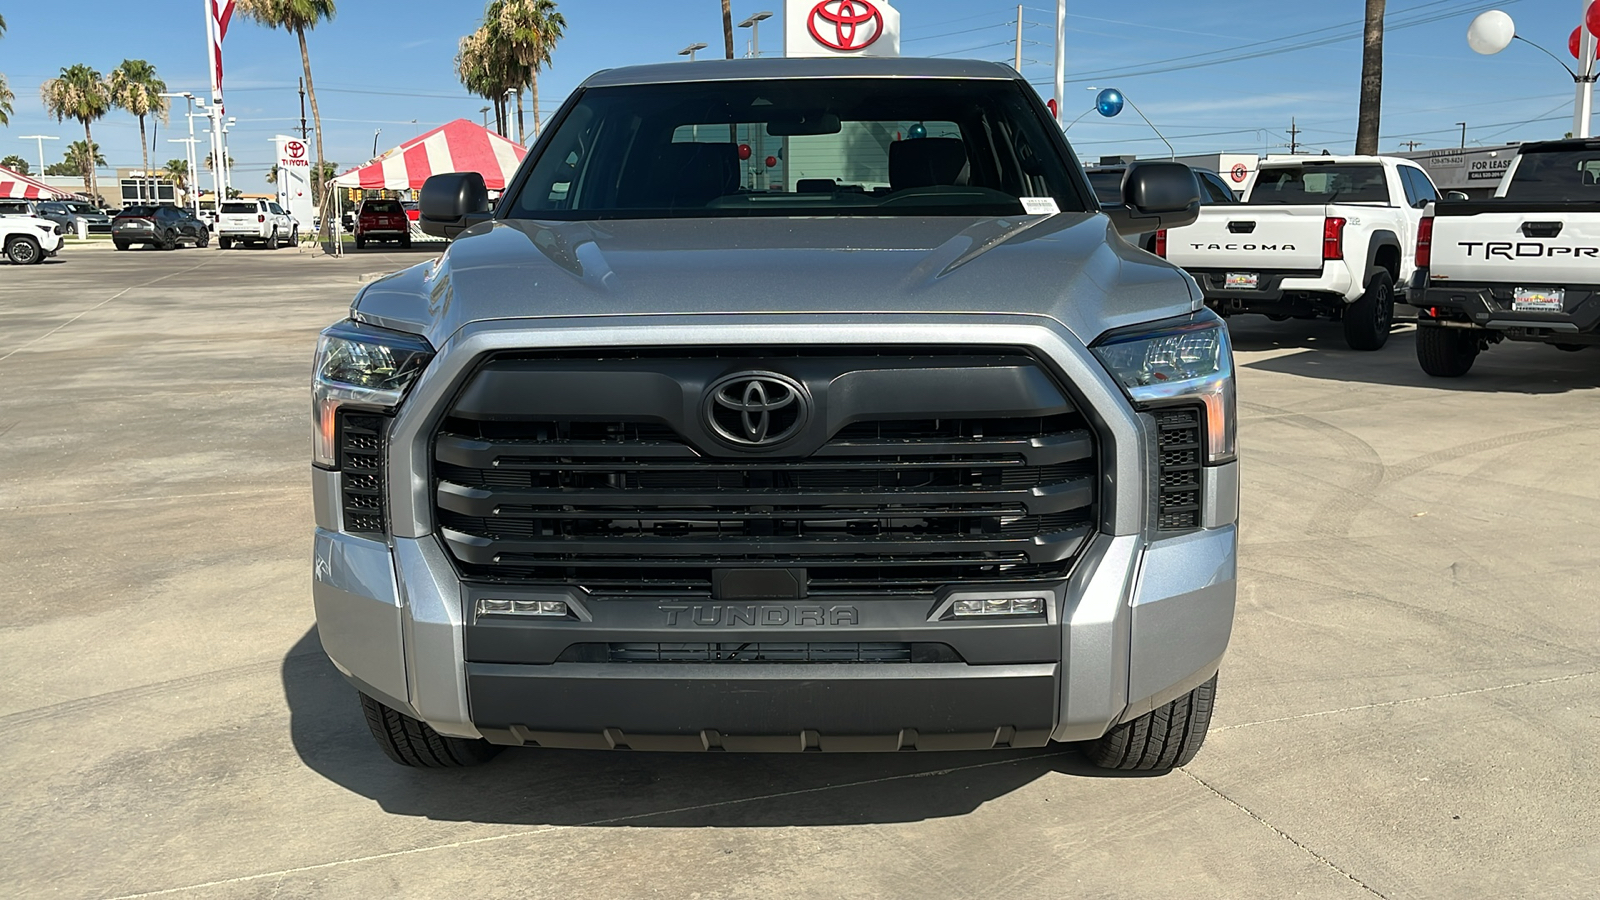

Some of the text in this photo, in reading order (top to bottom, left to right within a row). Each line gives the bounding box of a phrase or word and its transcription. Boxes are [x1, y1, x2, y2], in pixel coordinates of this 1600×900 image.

[1472, 161, 1487, 170] FOR
[1190, 243, 1296, 251] TACOMA
[1458, 242, 1543, 260] TRD
[658, 605, 859, 626] TUNDRA
